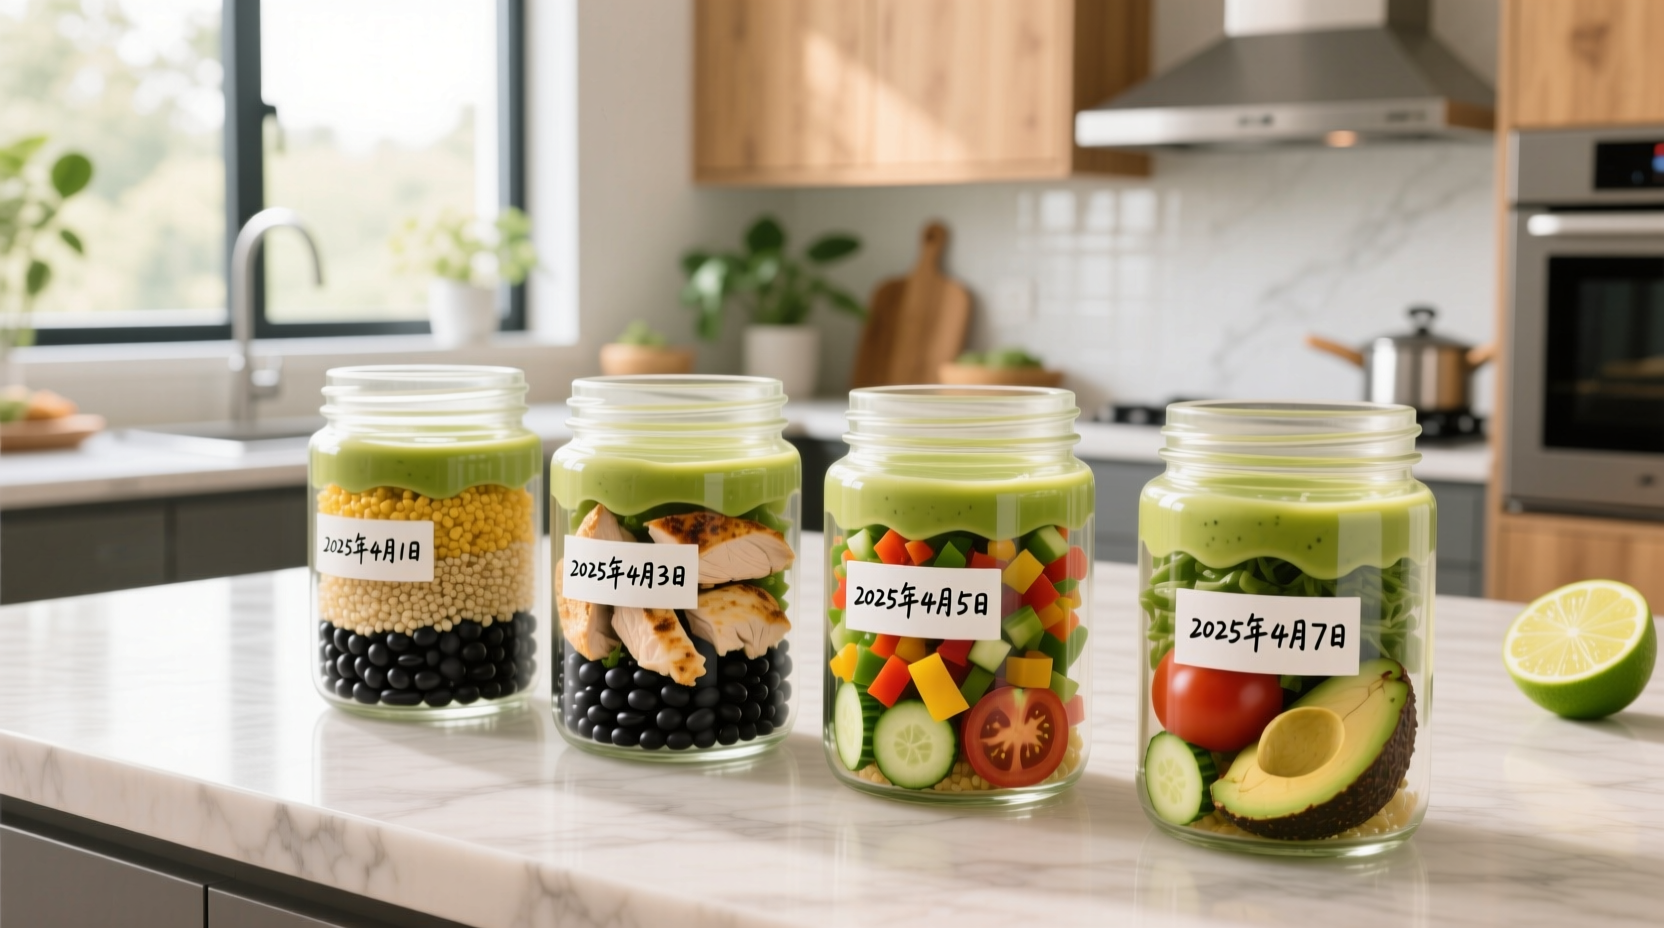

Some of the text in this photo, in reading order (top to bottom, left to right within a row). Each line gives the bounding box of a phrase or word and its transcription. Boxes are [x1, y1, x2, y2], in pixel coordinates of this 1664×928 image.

[323, 532, 420, 565] 2025年4月1日
[570, 556, 686, 590] 2025年4月3日
[854, 582, 989, 620] 2025年4月5日
[1189, 612, 1346, 653] 2025年4月7日
